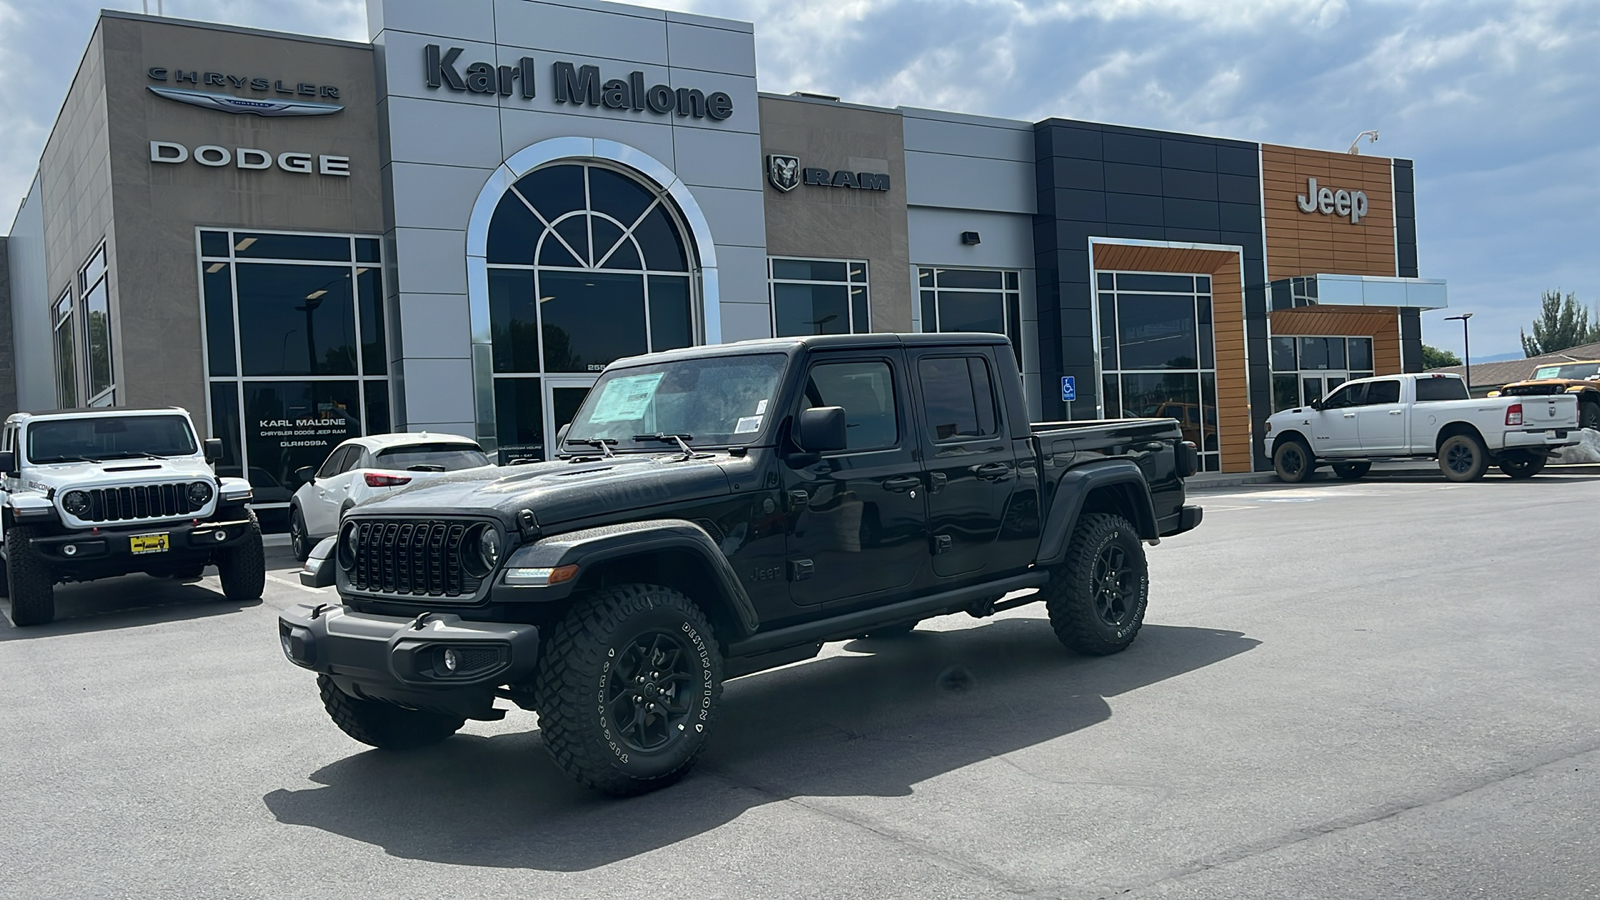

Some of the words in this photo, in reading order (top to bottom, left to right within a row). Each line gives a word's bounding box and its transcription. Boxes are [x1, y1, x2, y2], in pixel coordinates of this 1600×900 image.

[147, 66, 341, 98] CHRYSLER
[424, 44, 536, 100] Karl
[552, 60, 734, 121] Malone
[150, 140, 351, 177] DODGE
[803, 167, 890, 192] RAM
[1296, 177, 1368, 225] Jeep
[750, 566, 781, 582] Jeep
[681, 621, 712, 722] DESTINATION
